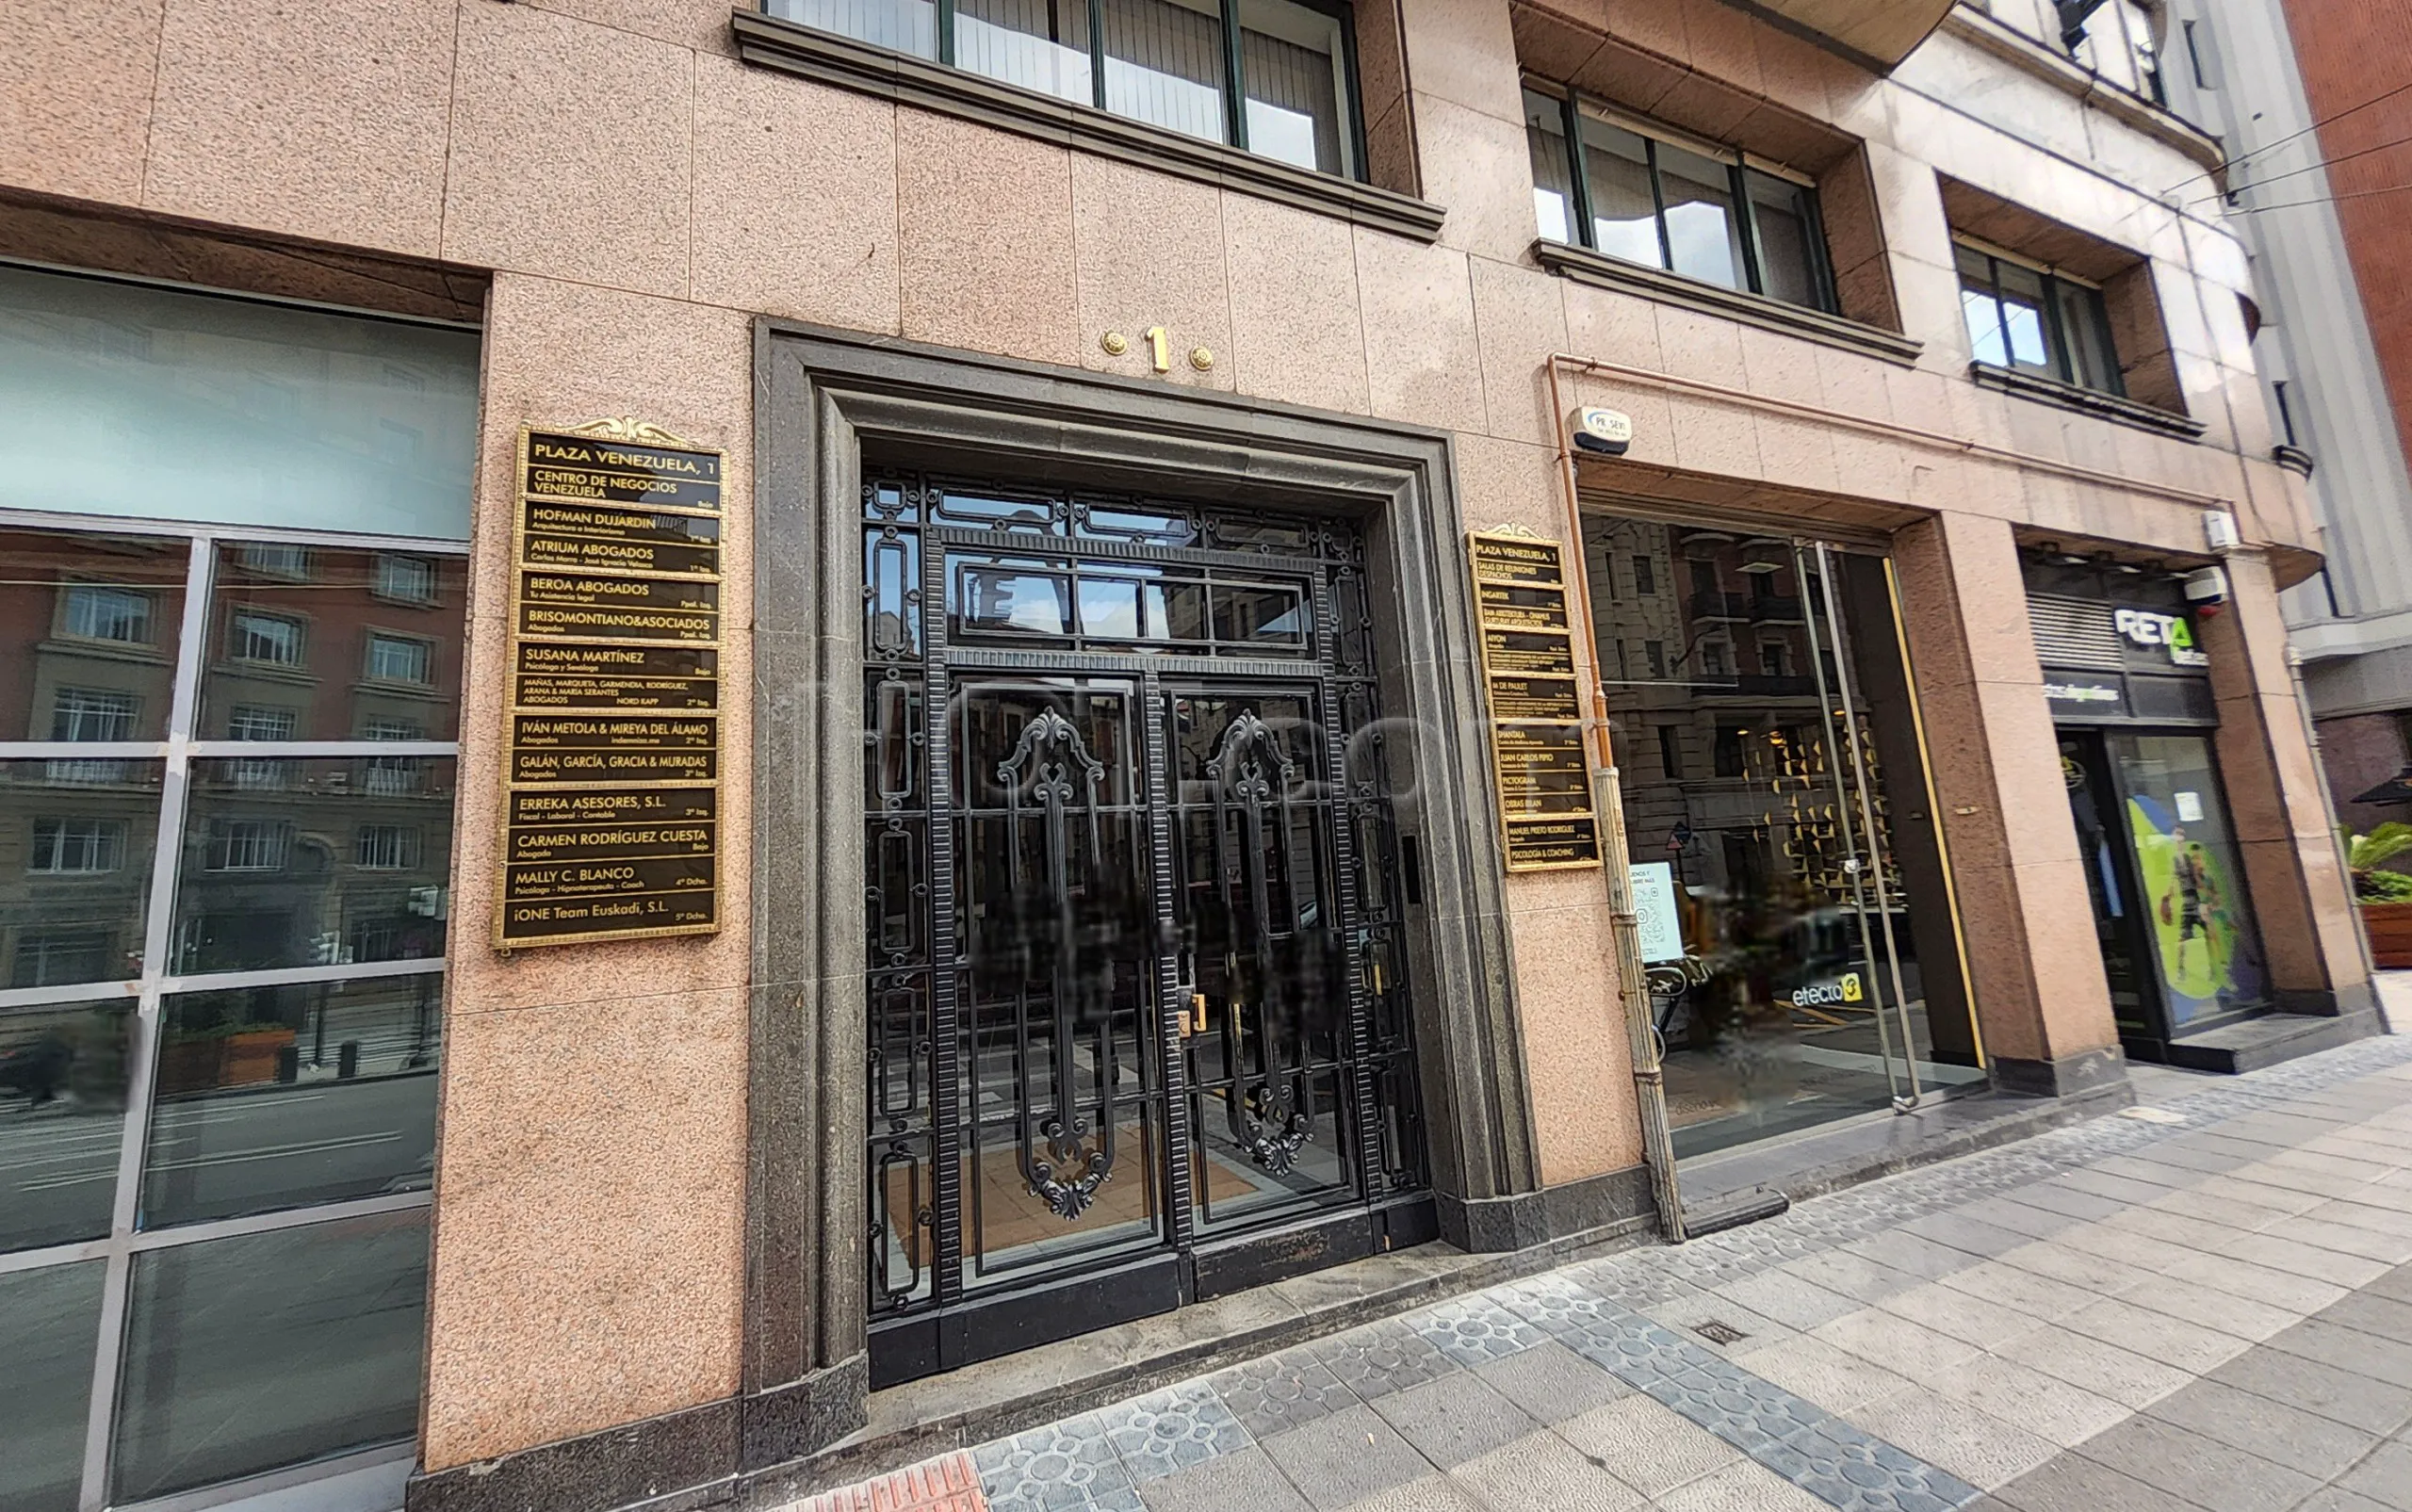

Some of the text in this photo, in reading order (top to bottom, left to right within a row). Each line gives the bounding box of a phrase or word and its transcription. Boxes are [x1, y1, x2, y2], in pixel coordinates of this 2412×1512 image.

[1145, 327, 1169, 371] 1
[535, 445, 714, 476] PLAZA VENEZUELA, 1
[535, 470, 676, 494] CENTRO DE NEGOCIOS
[534, 483, 606, 497] VENEZUELA
[533, 509, 656, 528] HOFMAN DUJARDIN
[532, 522, 576, 531] Arquitectura
[584, 527, 625, 535] Interiorismo
[531, 541, 654, 559] ATRIUM ABOGADOS
[531, 553, 554, 561] Carlos
[1476, 545, 1556, 562] PLAZA VENEZUELA, 1
[1506, 565, 1537, 575] REUNIONES
[530, 578, 649, 595] BEROA ABOGADOS
[540, 593, 576, 601] Asistencia
[529, 610, 709, 629] BRISOMONTIANO&ASOCIADOS
[528, 624, 564, 632] Abogados
[2115, 610, 2192, 646] RETA
[526, 649, 644, 663] SUSANA MARTÍNEZ
[525, 663, 559, 672] Psicóloga
[525, 679, 554, 688] MAÑAS,
[522, 720, 708, 735] IVÁN METOLA & MIREYA DEL ÁLAMO
[520, 754, 707, 769] GALÁN, GARCÍA, GRACIA & MURADAS
[520, 796, 666, 810] ERREKA ASESORES, S.L.
[518, 830, 707, 847] CARMEN RODRÍGUEZ CUESTA
[515, 868, 634, 884] MALLY C. BLANCO
[515, 886, 550, 895] Psicóloga
[558, 883, 614, 893] Hipnoterapeuta
[514, 902, 669, 921] iONE Team Euskadi, S.L.
